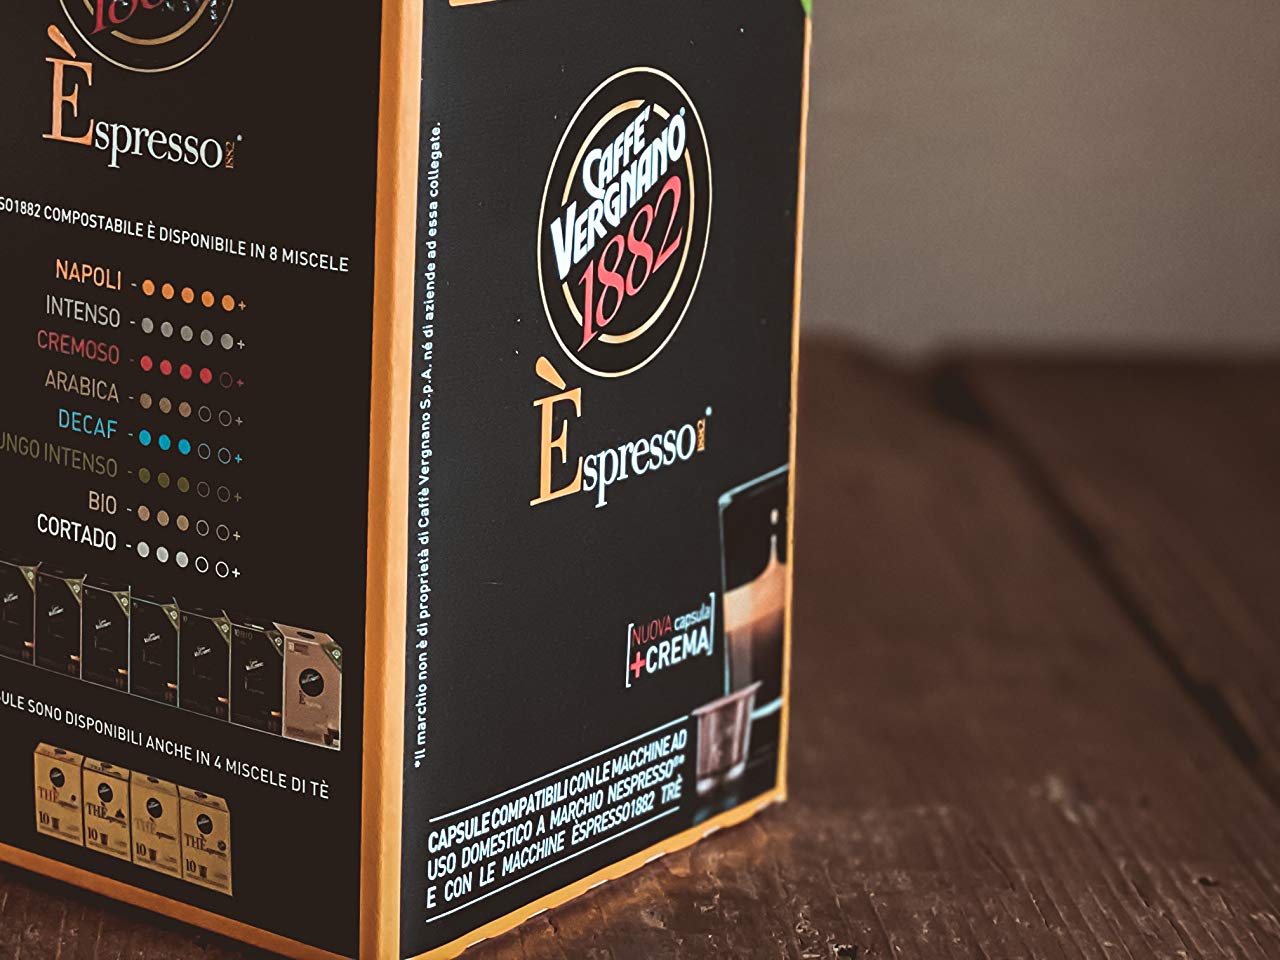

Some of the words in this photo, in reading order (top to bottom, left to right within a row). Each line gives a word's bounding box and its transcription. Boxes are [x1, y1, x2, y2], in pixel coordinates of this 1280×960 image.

[428, 122, 442, 197] collegate.
[550, 113, 686, 280] VERGNANO
[428, 201, 438, 237] essa
[43, 205, 144, 238] COMPOSTABILE
[147, 220, 156, 240] È
[159, 226, 246, 256] DISPONIBILE
[250, 242, 266, 259] IN
[269, 246, 278, 261] 8
[282, 248, 349, 273] MISCELE
[426, 240, 437, 259] ad
[55, 258, 122, 291] NAPOLI
[577, 175, 683, 352] 1882
[423, 262, 436, 321] aziende
[46, 294, 121, 328] INTENSO
[37, 330, 120, 365] CREMOSO
[422, 324, 434, 338] di
[421, 341, 433, 360] né
[45, 369, 120, 403] ARABICA
[420, 363, 434, 410] S.p.A.
[58, 408, 117, 438] DECAF
[44, 445, 118, 477] INTENSO
[418, 412, 433, 486] Vergnano
[88, 490, 117, 515] BIO
[417, 487, 430, 528] Caffè
[37, 513, 117, 551] CORTADO
[418, 530, 430, 545] di
[417, 548, 432, 619] proprietà
[416, 622, 429, 636] di
[416, 640, 428, 649] è
[418, 652, 428, 681] non
[415, 683, 428, 746] marchio
[28, 699, 62, 722] SONO
[66, 710, 143, 747] DISPONIBILI
[146, 735, 192, 761] ANCHE
[196, 748, 210, 766] IN
[213, 754, 223, 769] 4
[226, 757, 288, 788] MISCELE
[291, 776, 307, 793] DI
[310, 777, 330, 800] TÈ
[427, 811, 491, 853] CAPSULE
[491, 779, 568, 830] COMPATIBILI
[569, 767, 594, 796] CON
[596, 761, 611, 785] LE
[611, 735, 671, 778] MACCHINE
[671, 728, 687, 753] AD
[427, 852, 457, 881] USO
[461, 819, 533, 869] DOMESTICO
[535, 814, 546, 837] A
[549, 789, 604, 830] MARCHIO
[426, 886, 437, 909] E
[444, 871, 472, 902] CON
[479, 861, 497, 888] LE
[501, 830, 566, 877] MACCHINE
